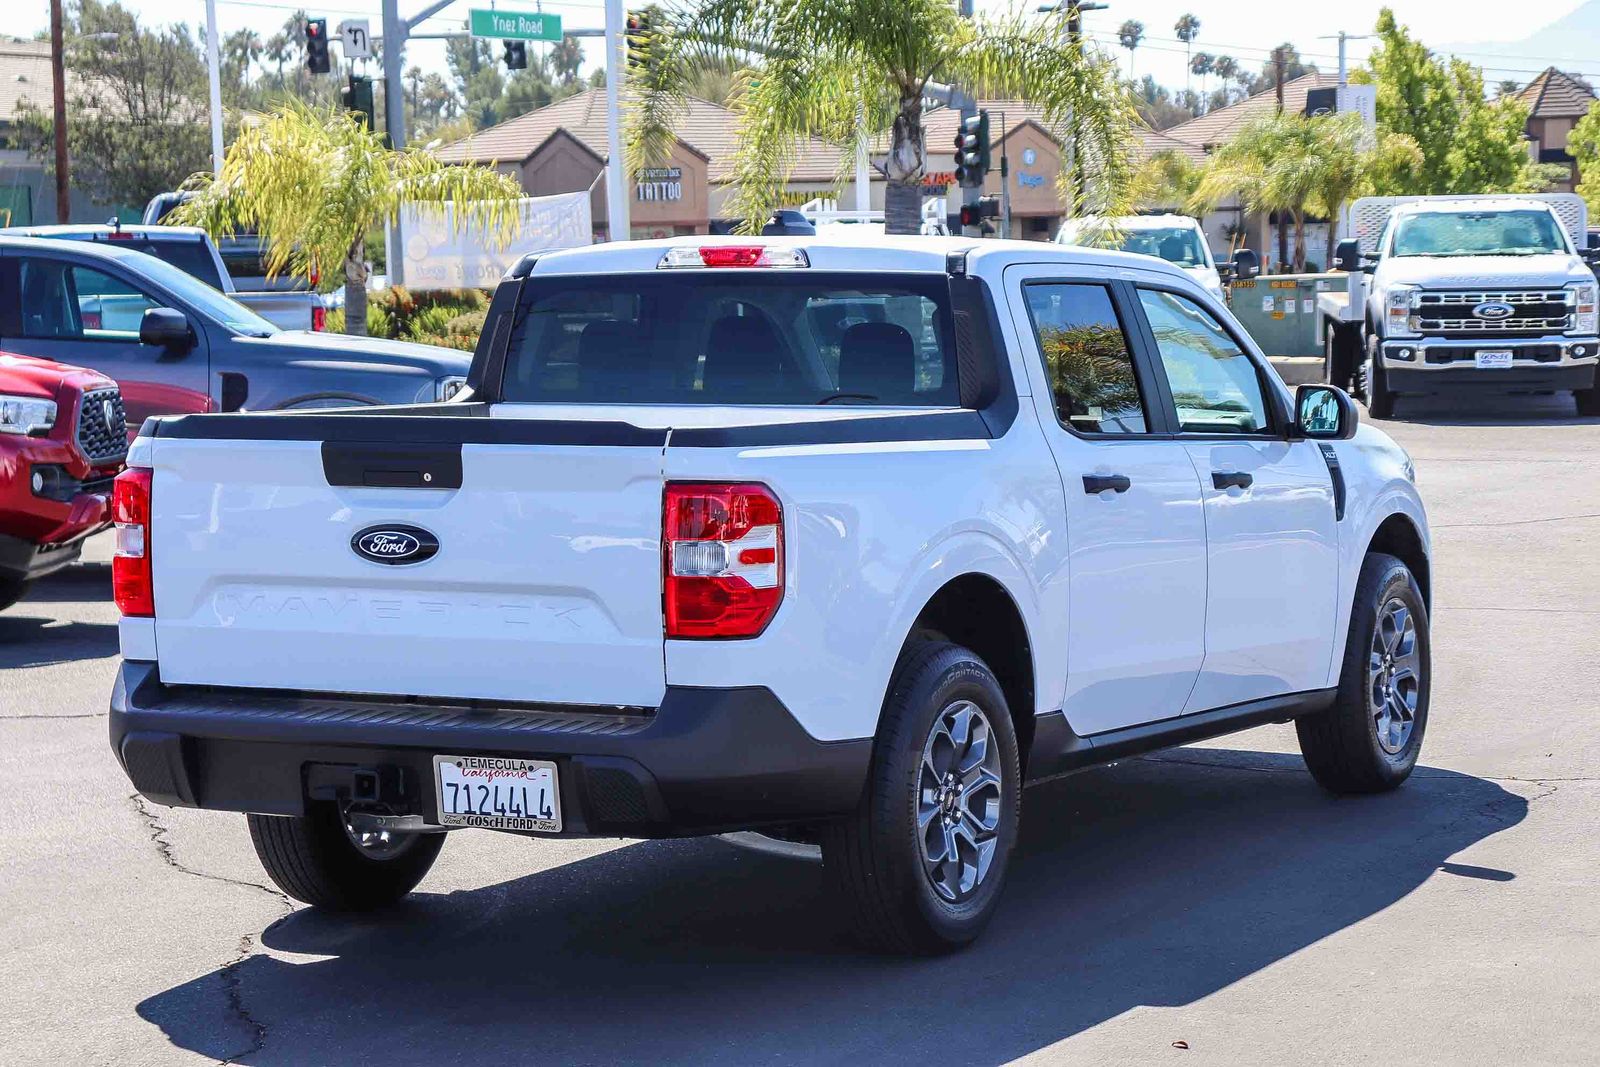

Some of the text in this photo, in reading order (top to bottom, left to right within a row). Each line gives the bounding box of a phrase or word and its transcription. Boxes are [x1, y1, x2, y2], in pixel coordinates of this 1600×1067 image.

[492, 14, 543, 34] Ynez Road
[637, 182, 681, 200] TATTOO
[370, 534, 408, 553] Ford
[462, 757, 527, 771] TEMECULA
[446, 782, 553, 820] 71244L4
[443, 814, 463, 825] Ford
[506, 818, 533, 830] FORD
[538, 820, 558, 831] Ford
